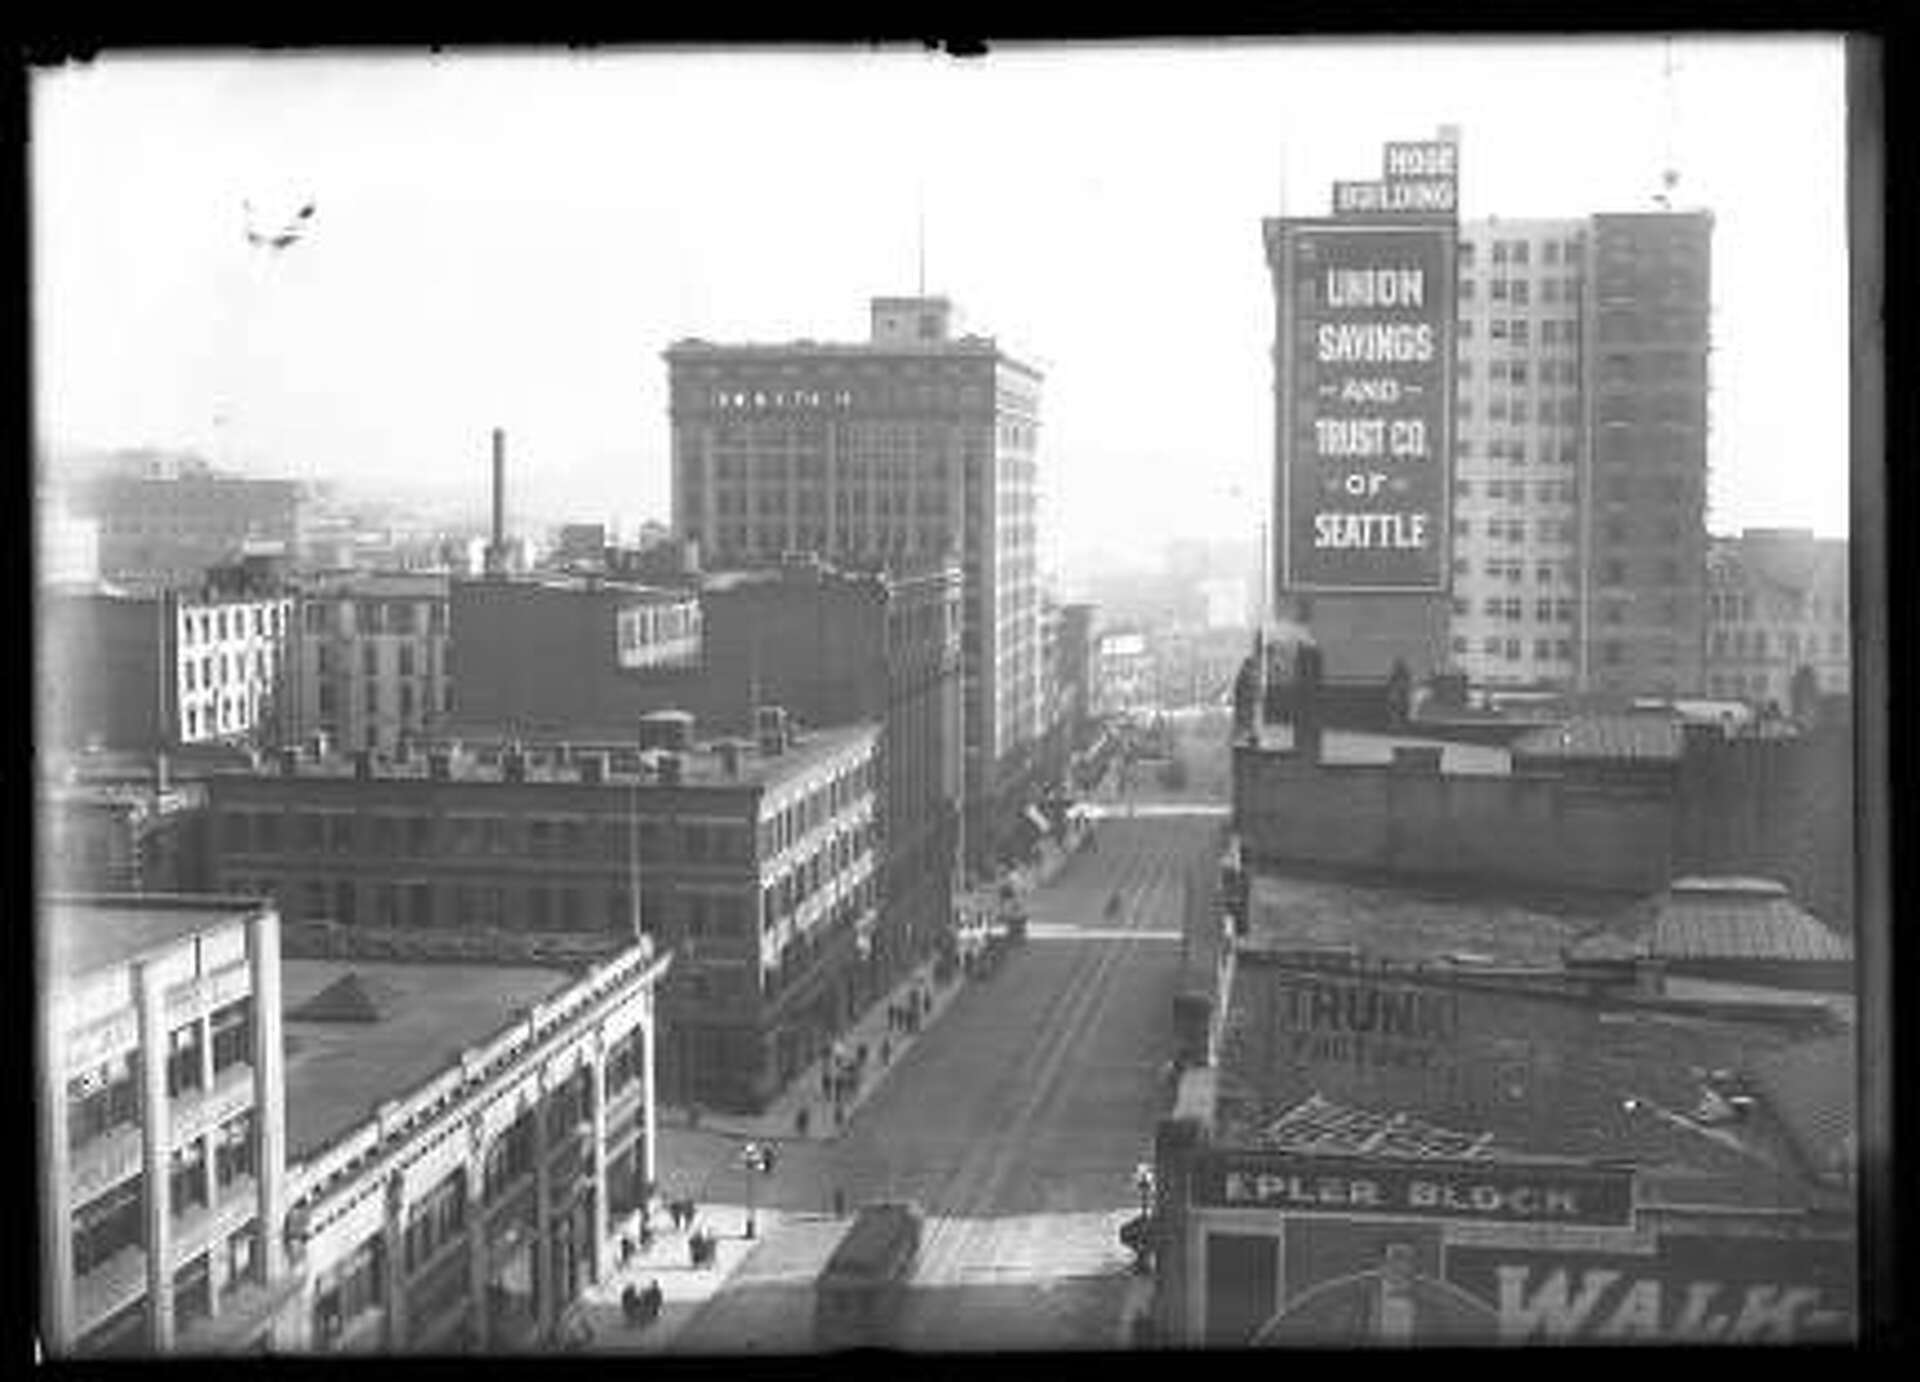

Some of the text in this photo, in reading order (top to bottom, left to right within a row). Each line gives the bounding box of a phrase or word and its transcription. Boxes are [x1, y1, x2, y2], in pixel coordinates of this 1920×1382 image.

[1327, 267, 1424, 308] UNION
[1317, 323, 1433, 363] SAVINGS
[1314, 419, 1386, 456] TRUST
[1314, 513, 1427, 548] SEATTLE
[1409, 1181, 1580, 1215] BLOCK
